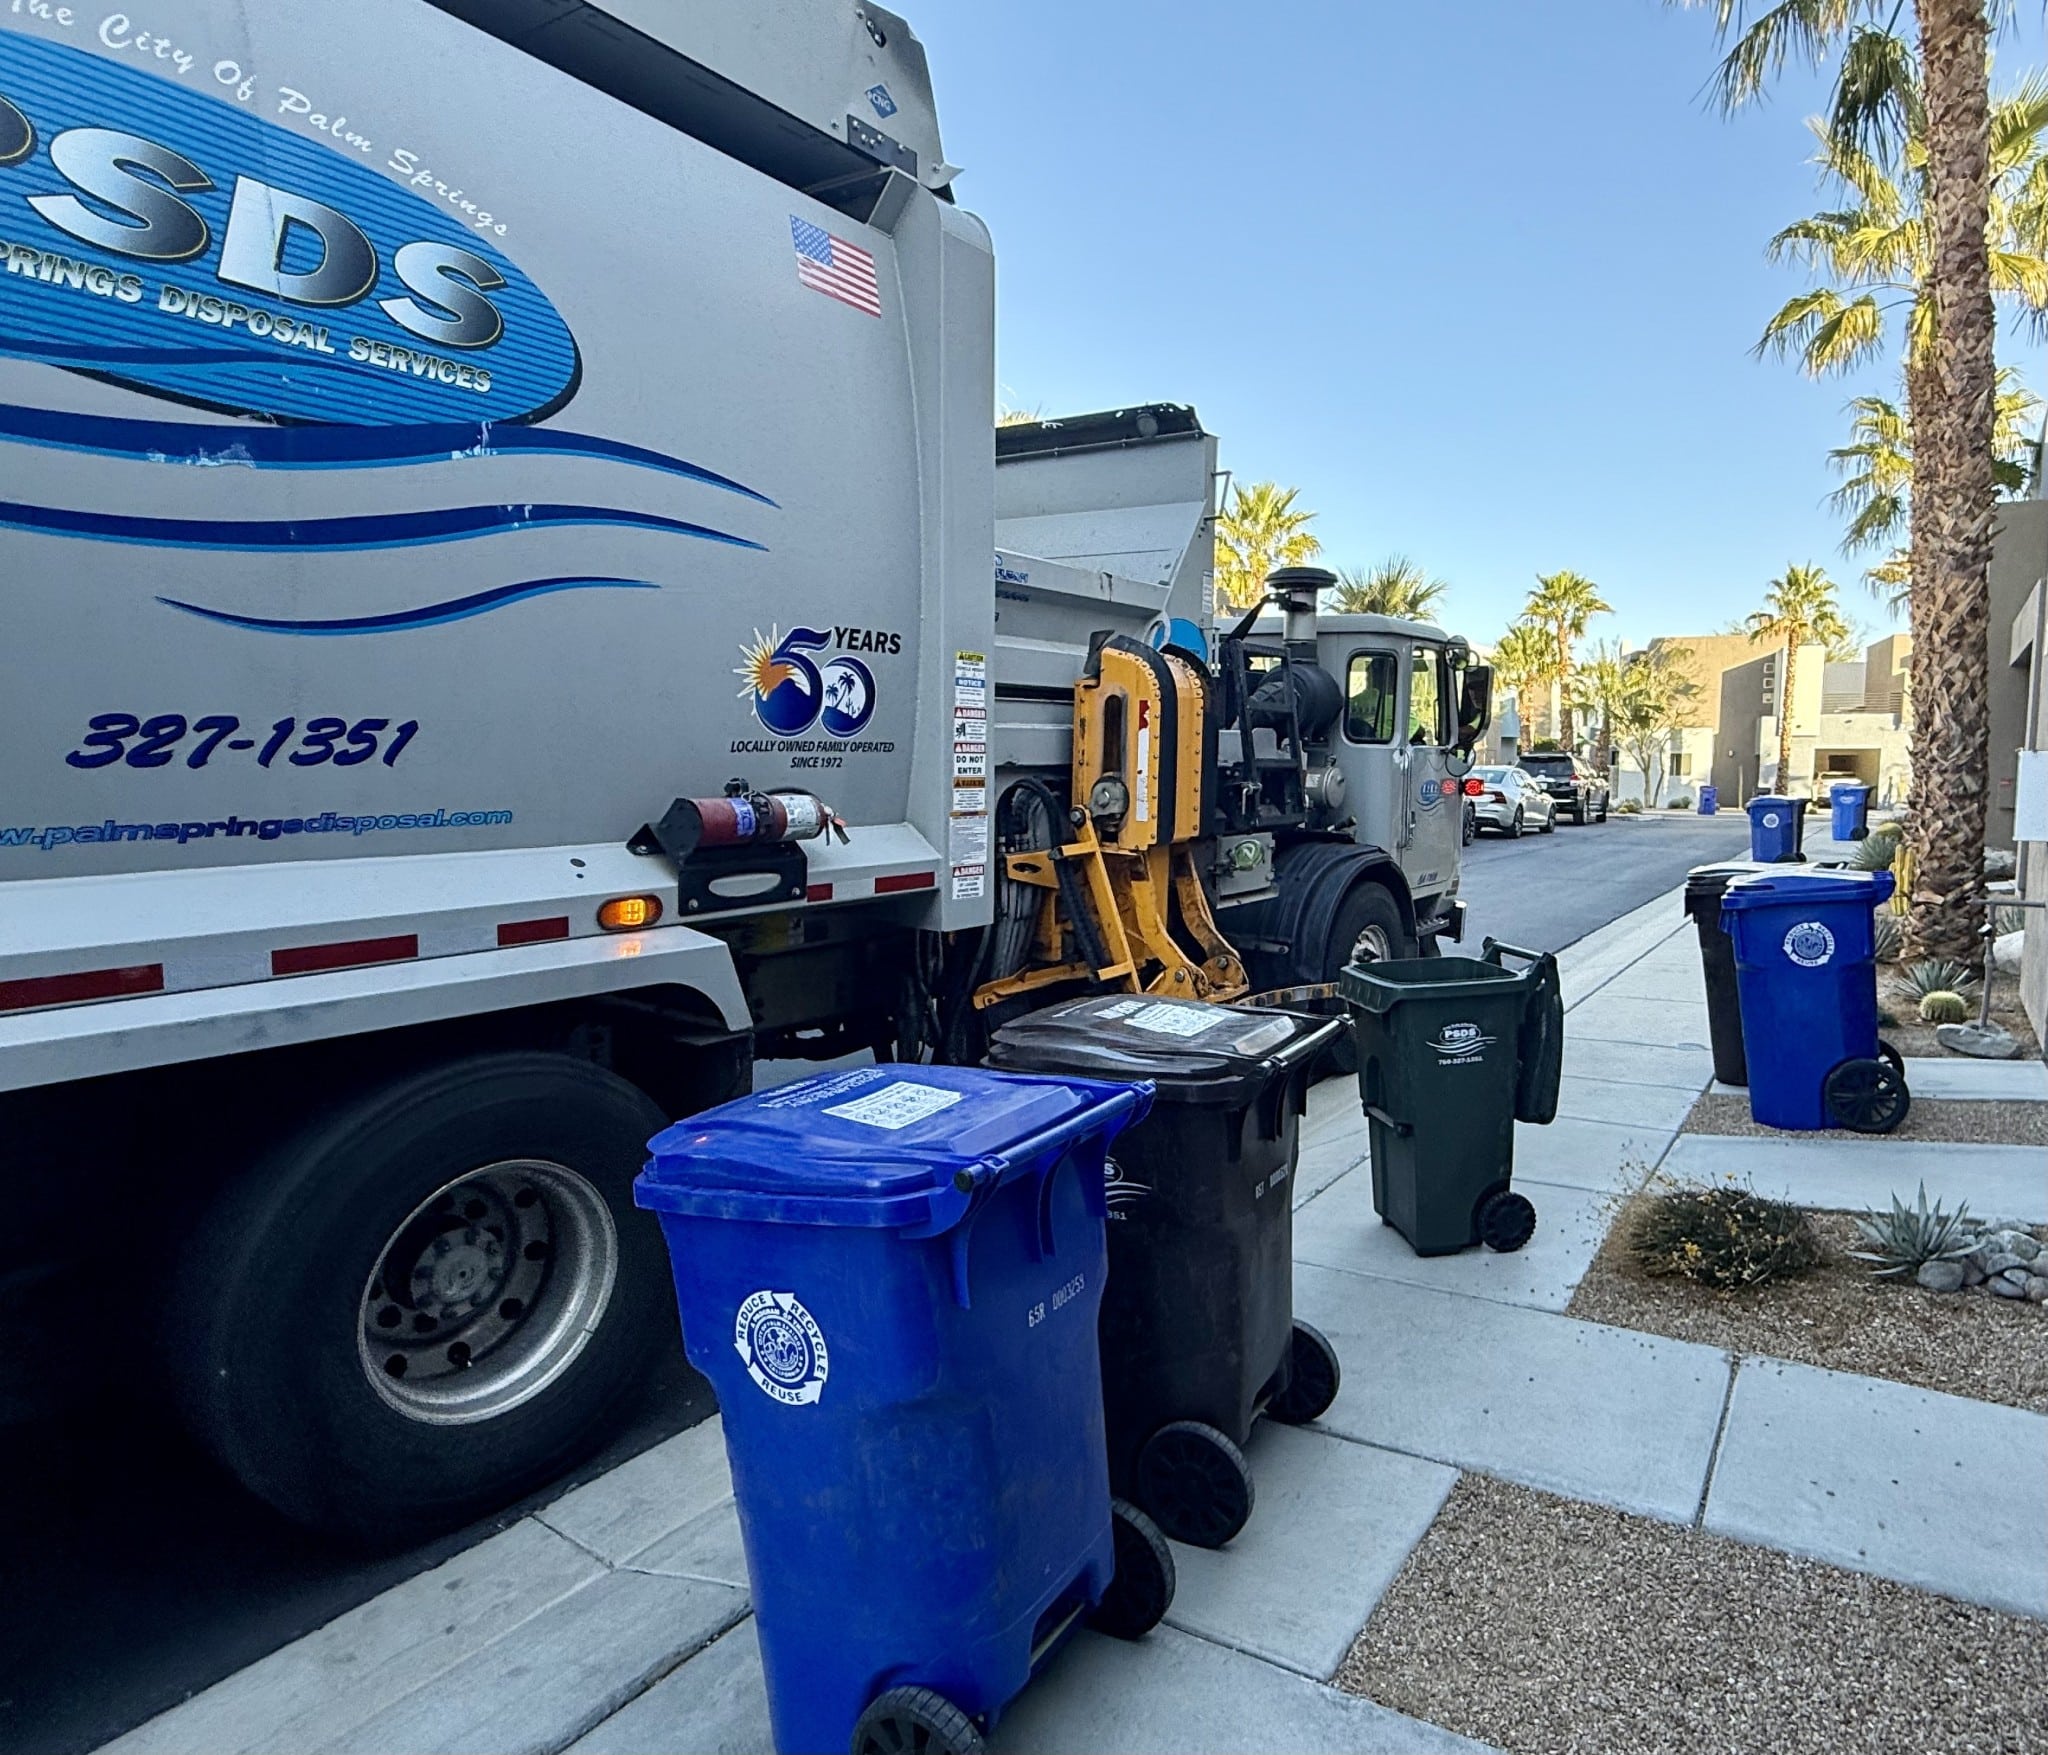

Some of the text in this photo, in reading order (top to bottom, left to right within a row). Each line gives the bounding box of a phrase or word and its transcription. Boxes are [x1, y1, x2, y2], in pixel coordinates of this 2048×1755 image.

[100, 14, 194, 74] City
[213, 60, 257, 101] Of
[278, 88, 373, 153] Palm
[388, 148, 508, 236] Springs
[157, 284, 336, 356] DISPOSAL
[347, 335, 494, 394] SERVICES
[834, 626, 901, 654] YEARS
[958, 679, 982, 687] NOTICE
[65, 713, 419, 770] 327-1351
[730, 741, 895, 753] LOCALLY OWNED FAMILY OPERATED
[790, 756, 843, 768] SINCE 1972
[956, 755, 984, 763] DO NOT
[957, 767, 982, 775] ENTER
[1444, 1028, 1477, 1039] PSDS
[737, 1294, 767, 1340] REDUCE
[1028, 1302, 1046, 1328] 65R
[790, 1302, 826, 1375] RECYCLE
[761, 1378, 804, 1402] REUSE
